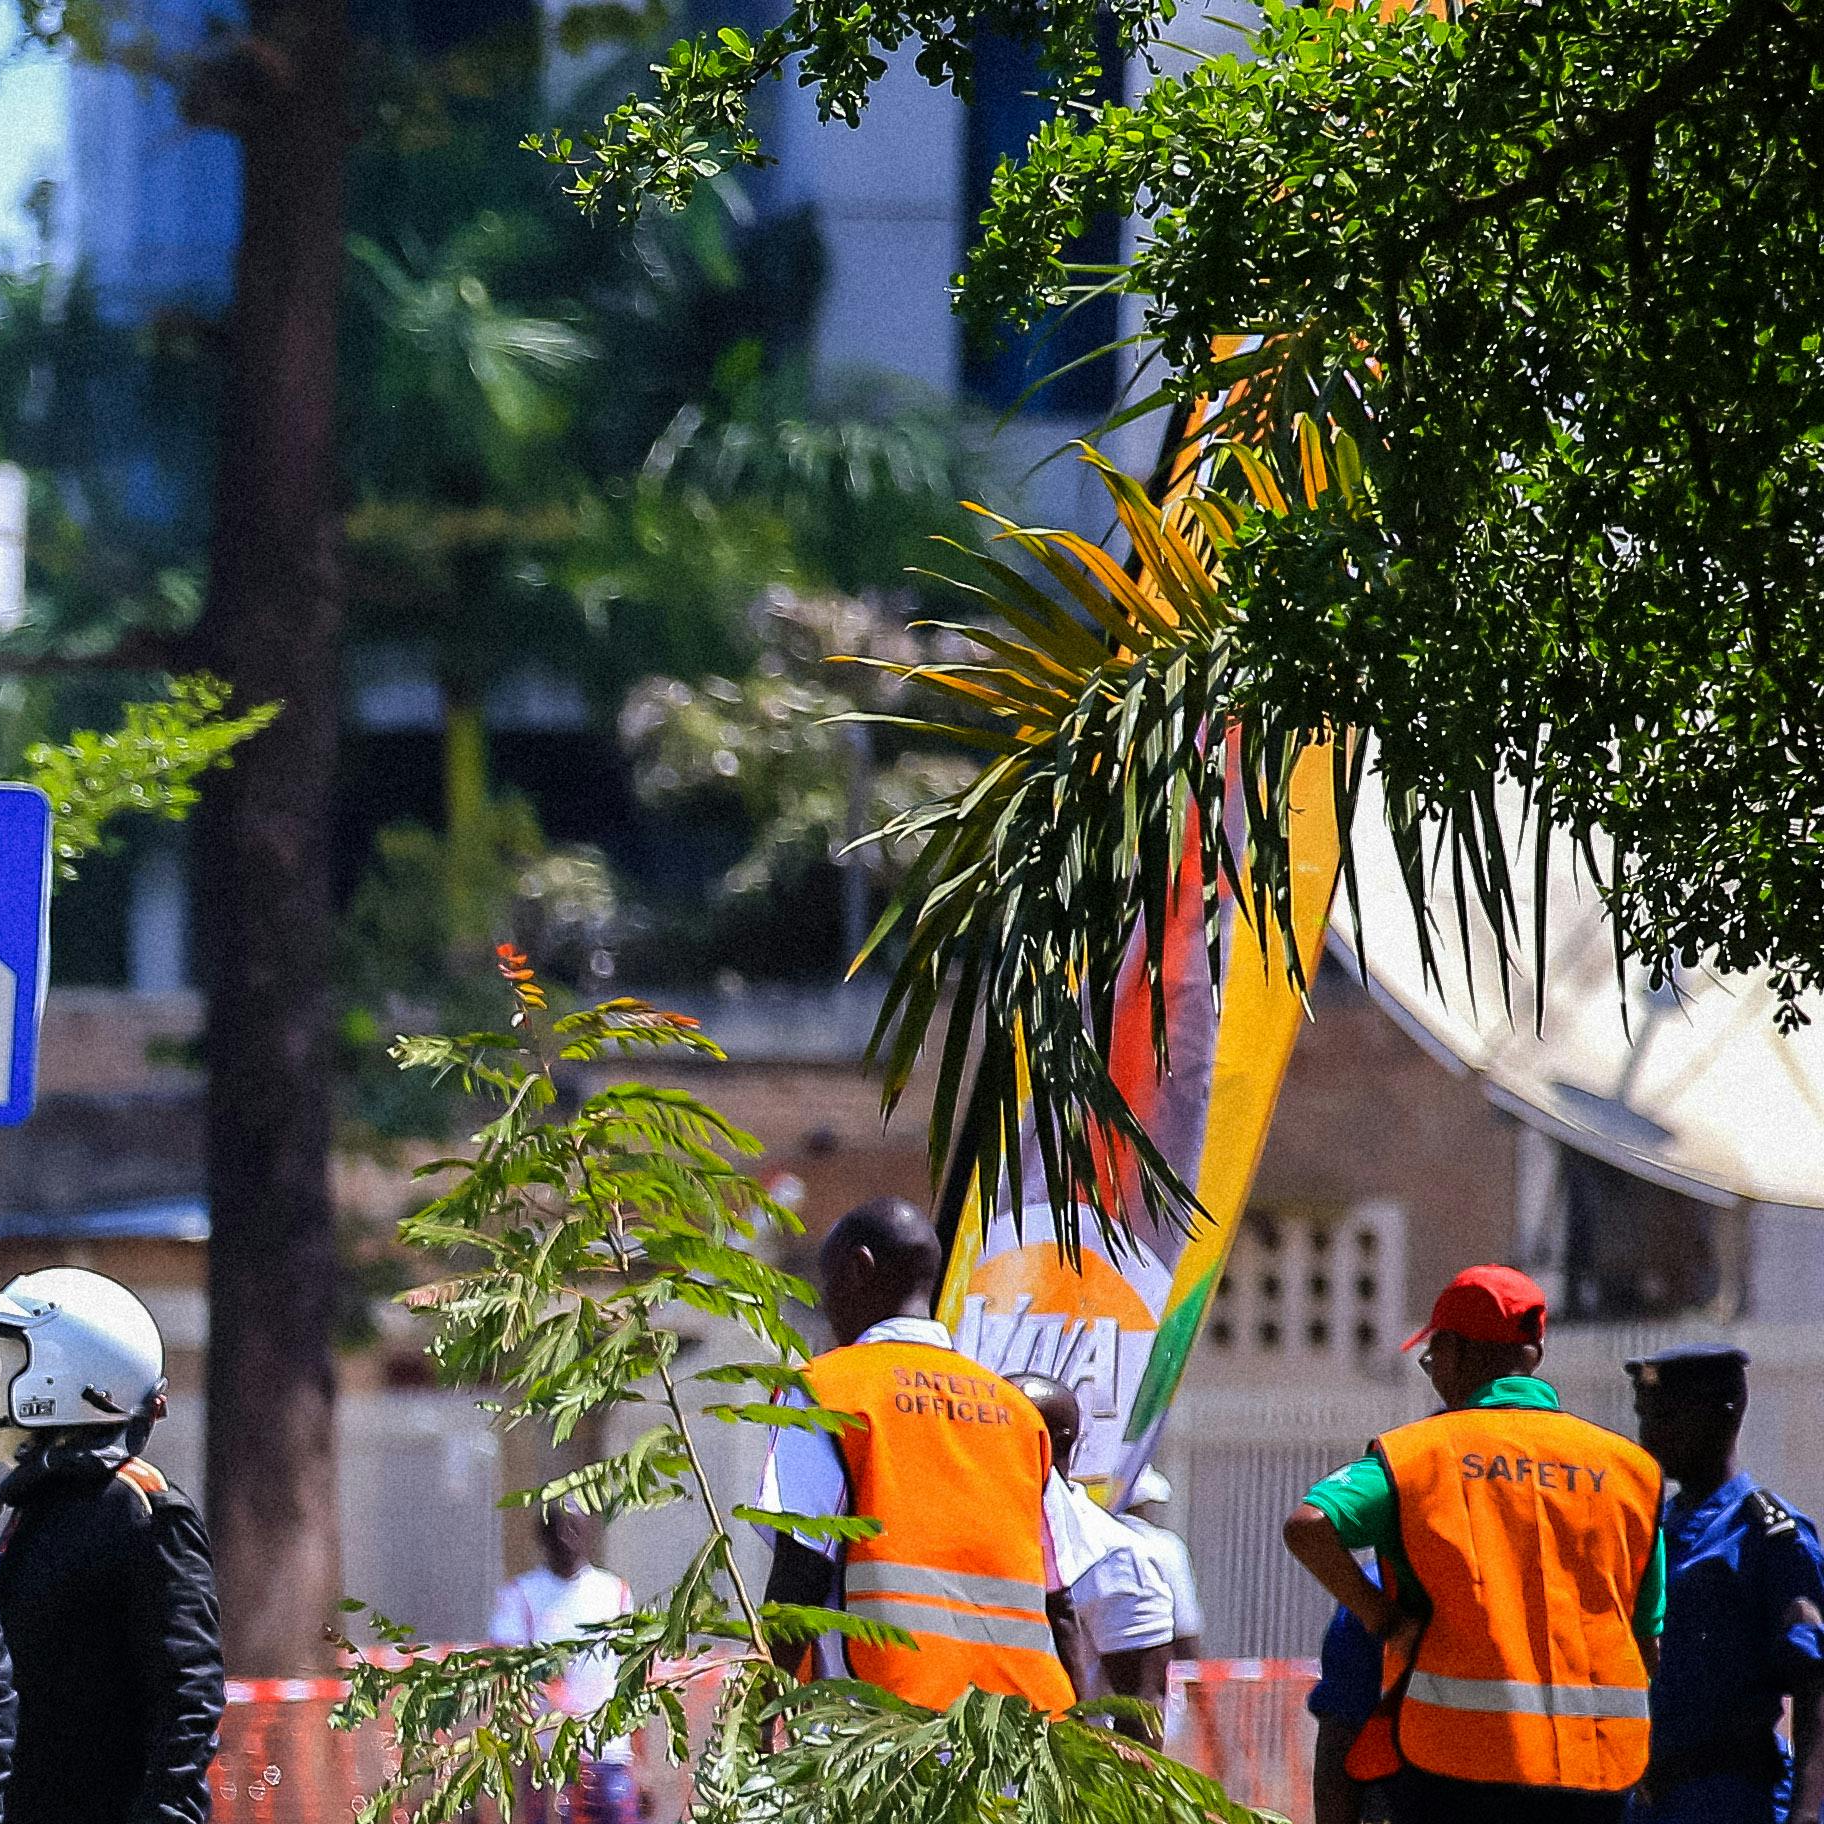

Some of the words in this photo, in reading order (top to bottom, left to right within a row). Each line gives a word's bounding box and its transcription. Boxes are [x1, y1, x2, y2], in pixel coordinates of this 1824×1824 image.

[893, 1367, 996, 1398] SAFETY
[895, 1393, 1011, 1425] OFFICER
[1462, 1453, 1605, 1492] SAFETY
